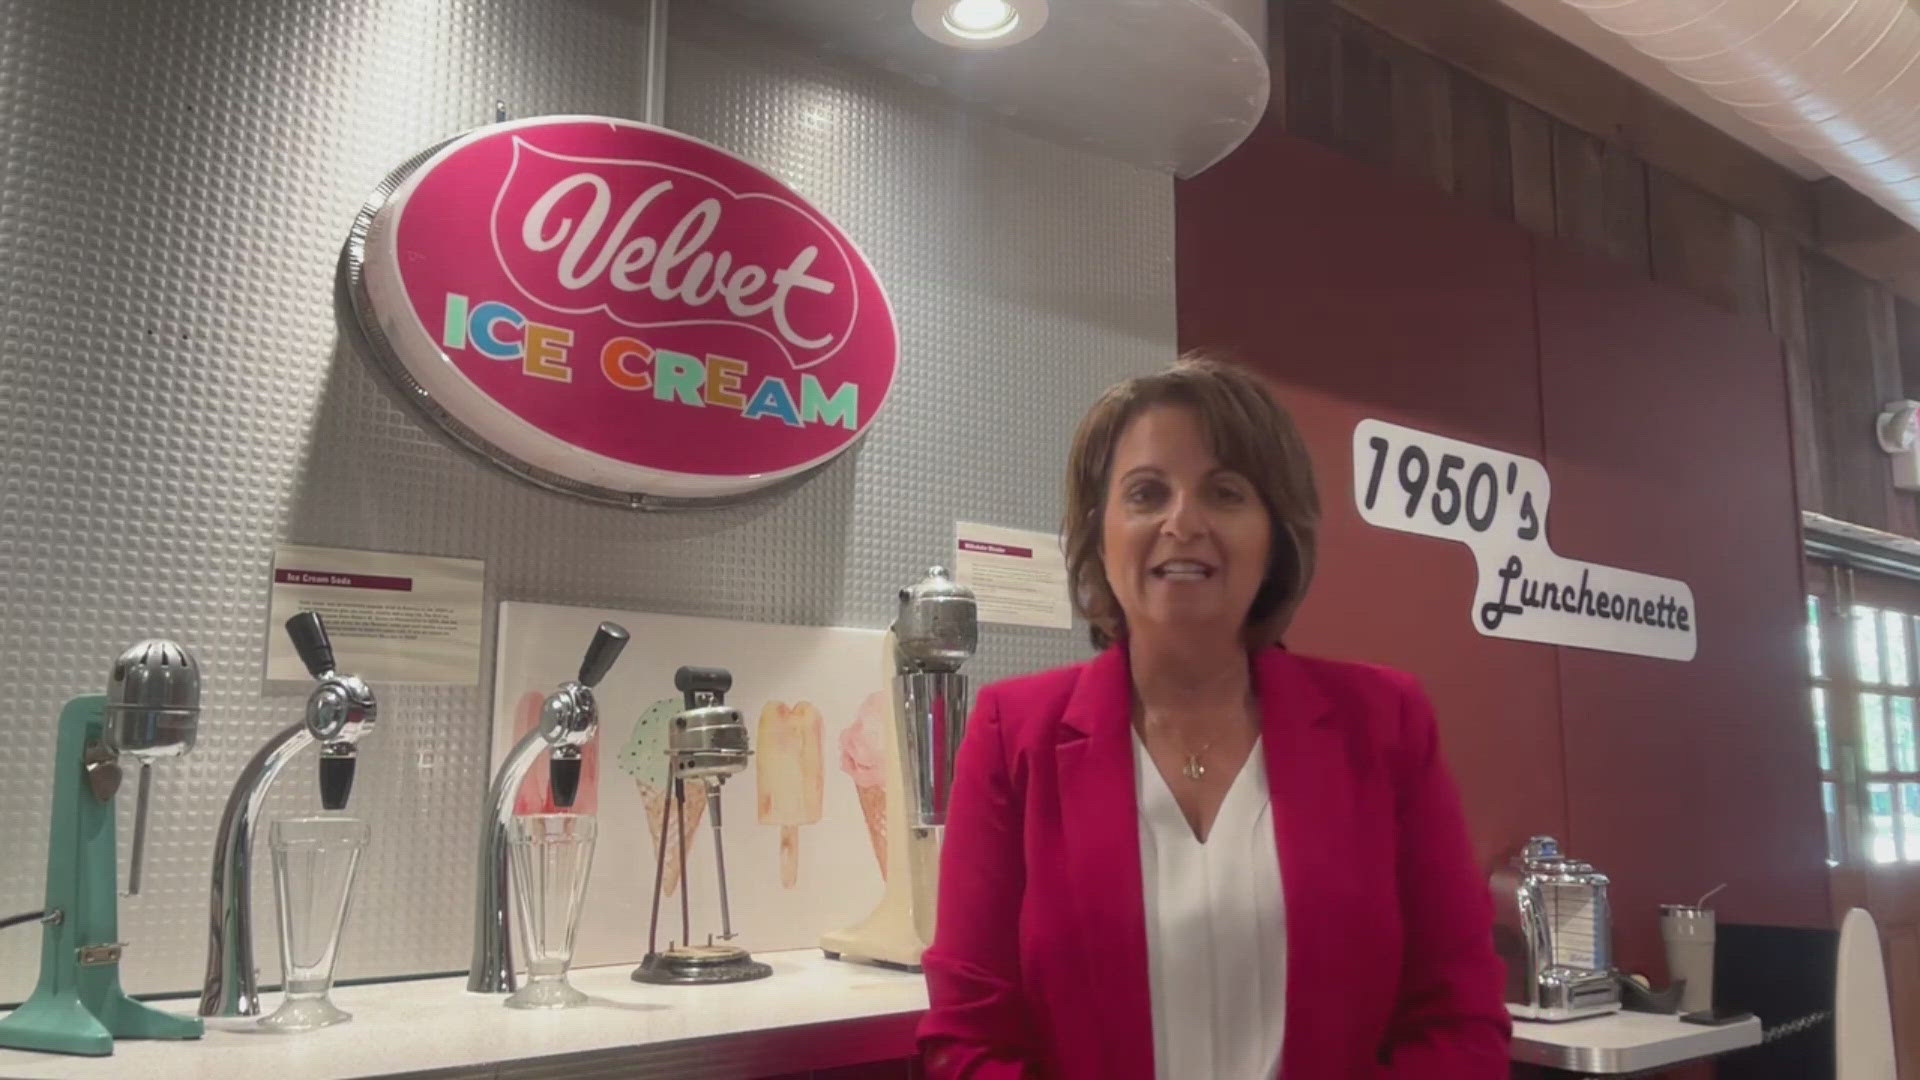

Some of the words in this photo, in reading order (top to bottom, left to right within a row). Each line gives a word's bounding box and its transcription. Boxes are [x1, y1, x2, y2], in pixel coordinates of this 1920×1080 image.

[522, 172, 835, 349] Velvet
[443, 291, 575, 384] ICE
[600, 336, 859, 431] CREAM
[1364, 436, 1540, 541] 1950's
[287, 572, 300, 582] Ice
[302, 573, 329, 584] Cream
[330, 575, 352, 586] Soda
[1480, 554, 1691, 632] Luncheonette
